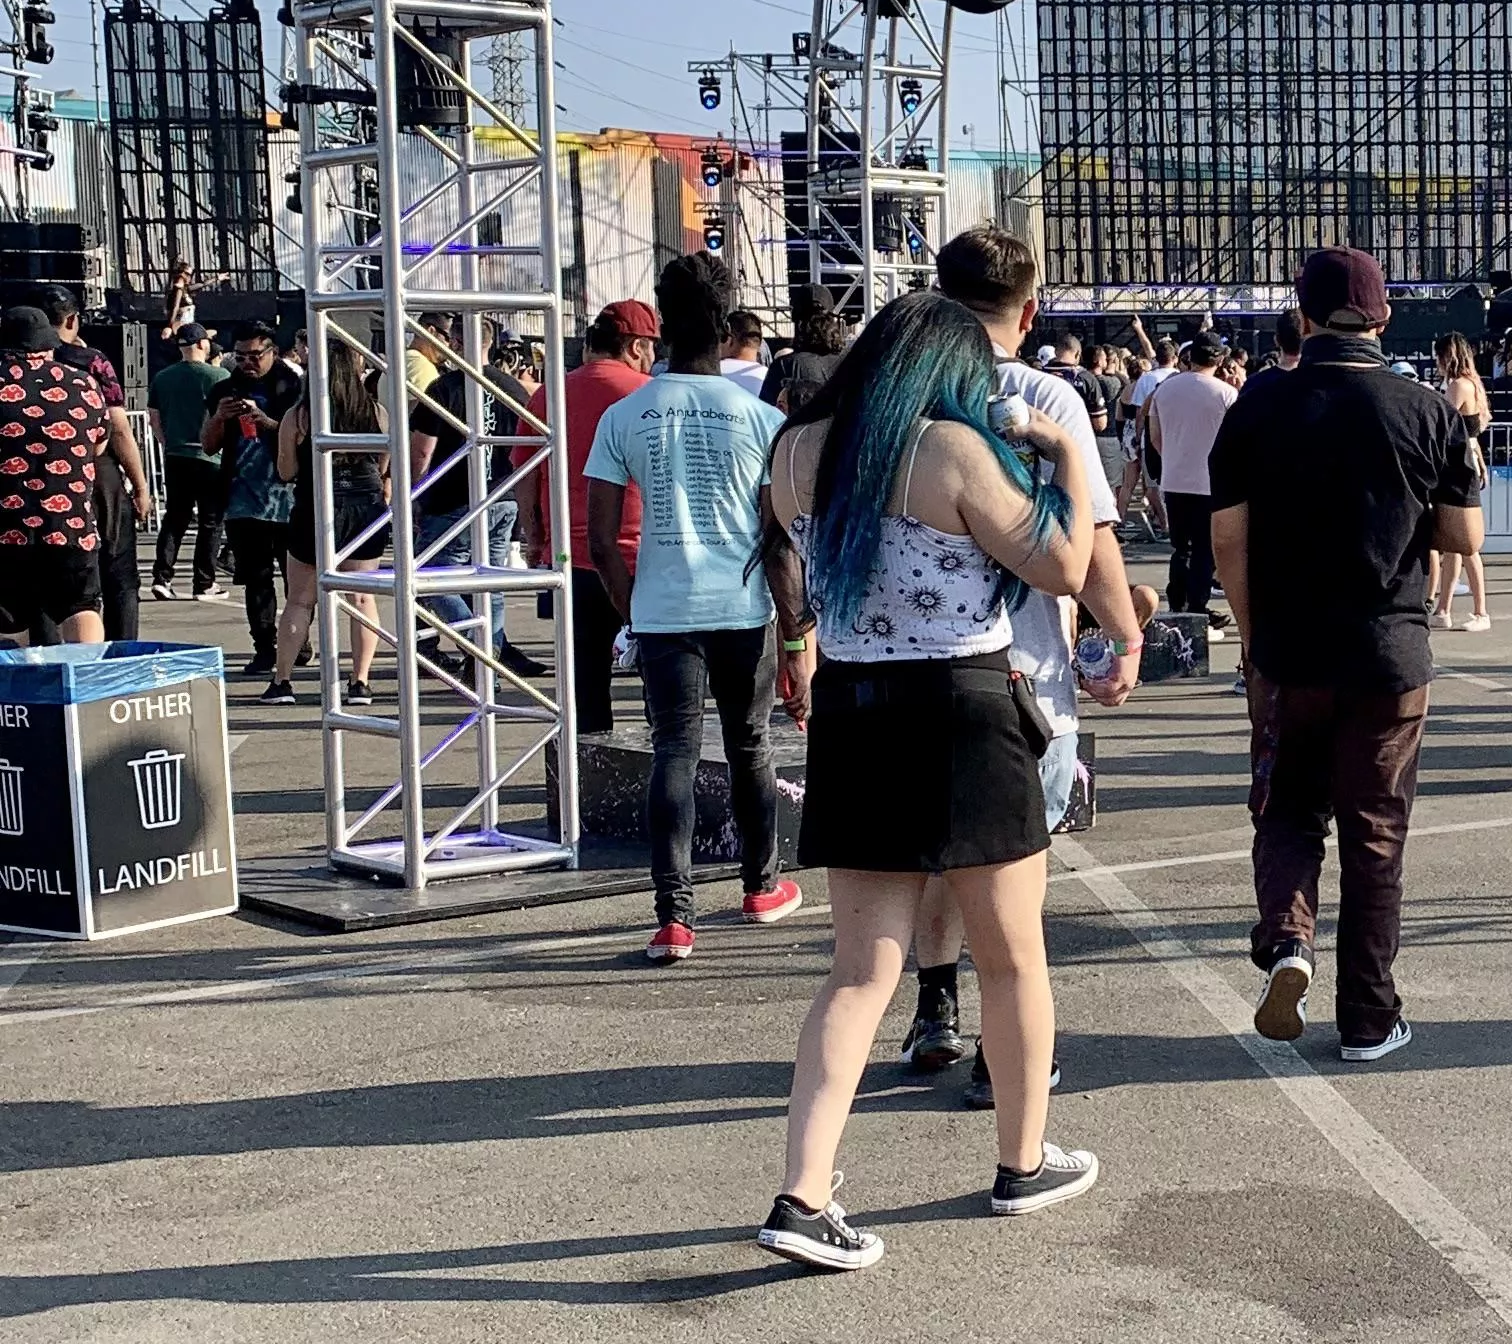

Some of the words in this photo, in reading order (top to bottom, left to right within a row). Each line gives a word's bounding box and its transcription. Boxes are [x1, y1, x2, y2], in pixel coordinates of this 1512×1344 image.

[666, 406, 745, 425] Anjunabeats
[110, 692, 192, 724] OTHER
[98, 848, 228, 895] LANDFILL
